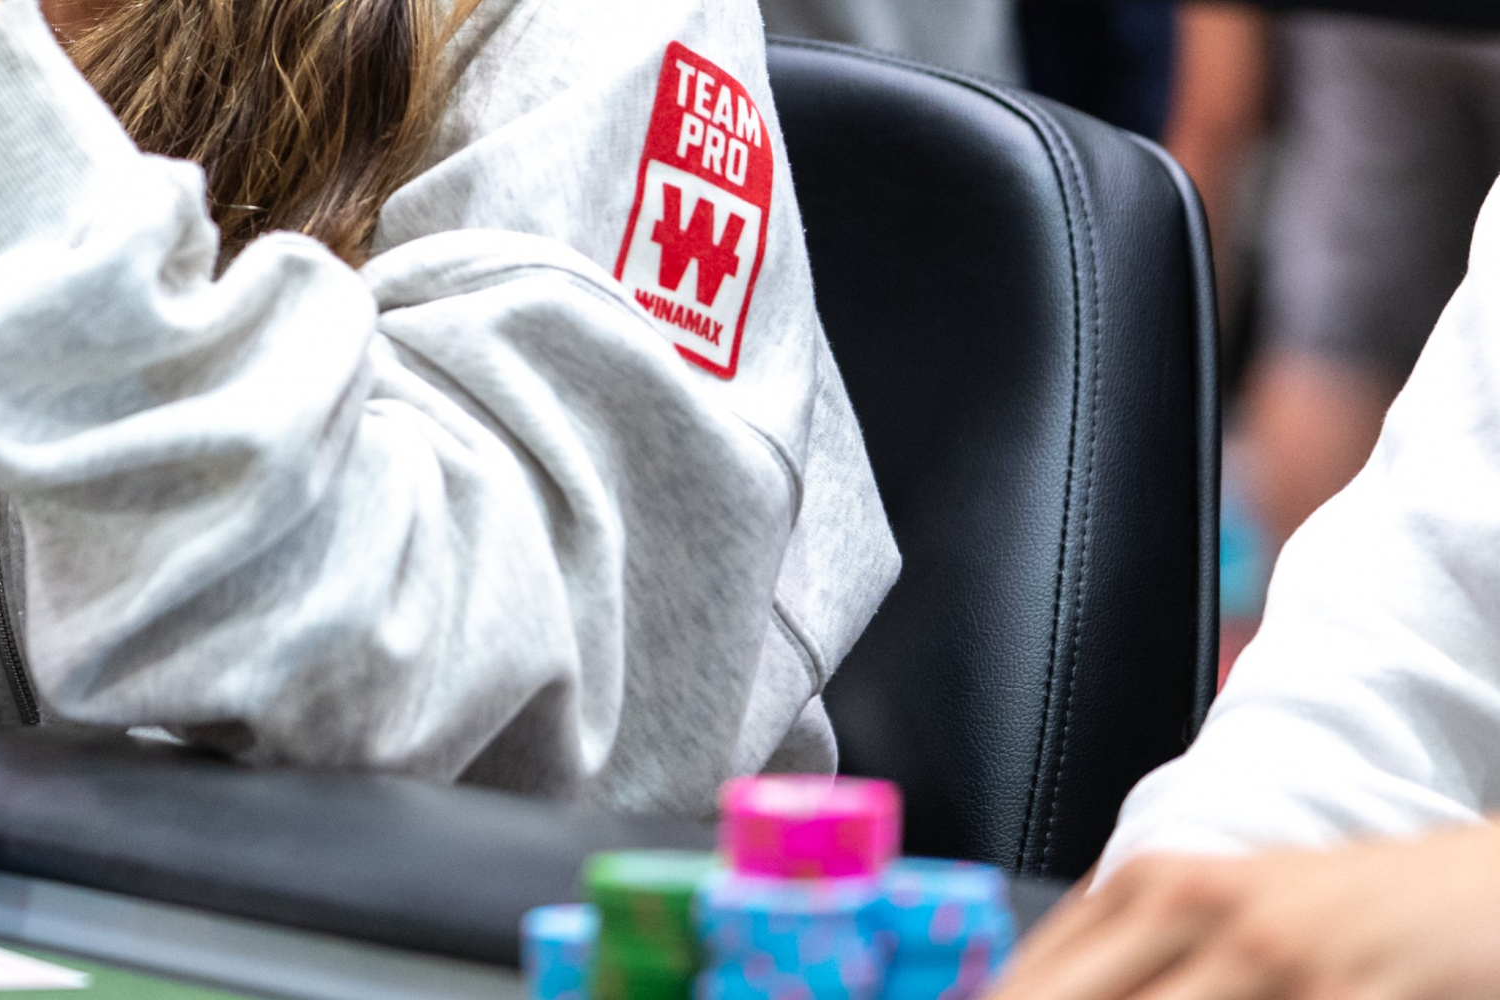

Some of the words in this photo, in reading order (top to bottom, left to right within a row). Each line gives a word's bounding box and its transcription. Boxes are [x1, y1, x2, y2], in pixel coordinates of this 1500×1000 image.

[675, 58, 762, 148] TEAM
[676, 111, 748, 187] PRO
[651, 182, 746, 307] W
[634, 288, 723, 347] WINAMAX
